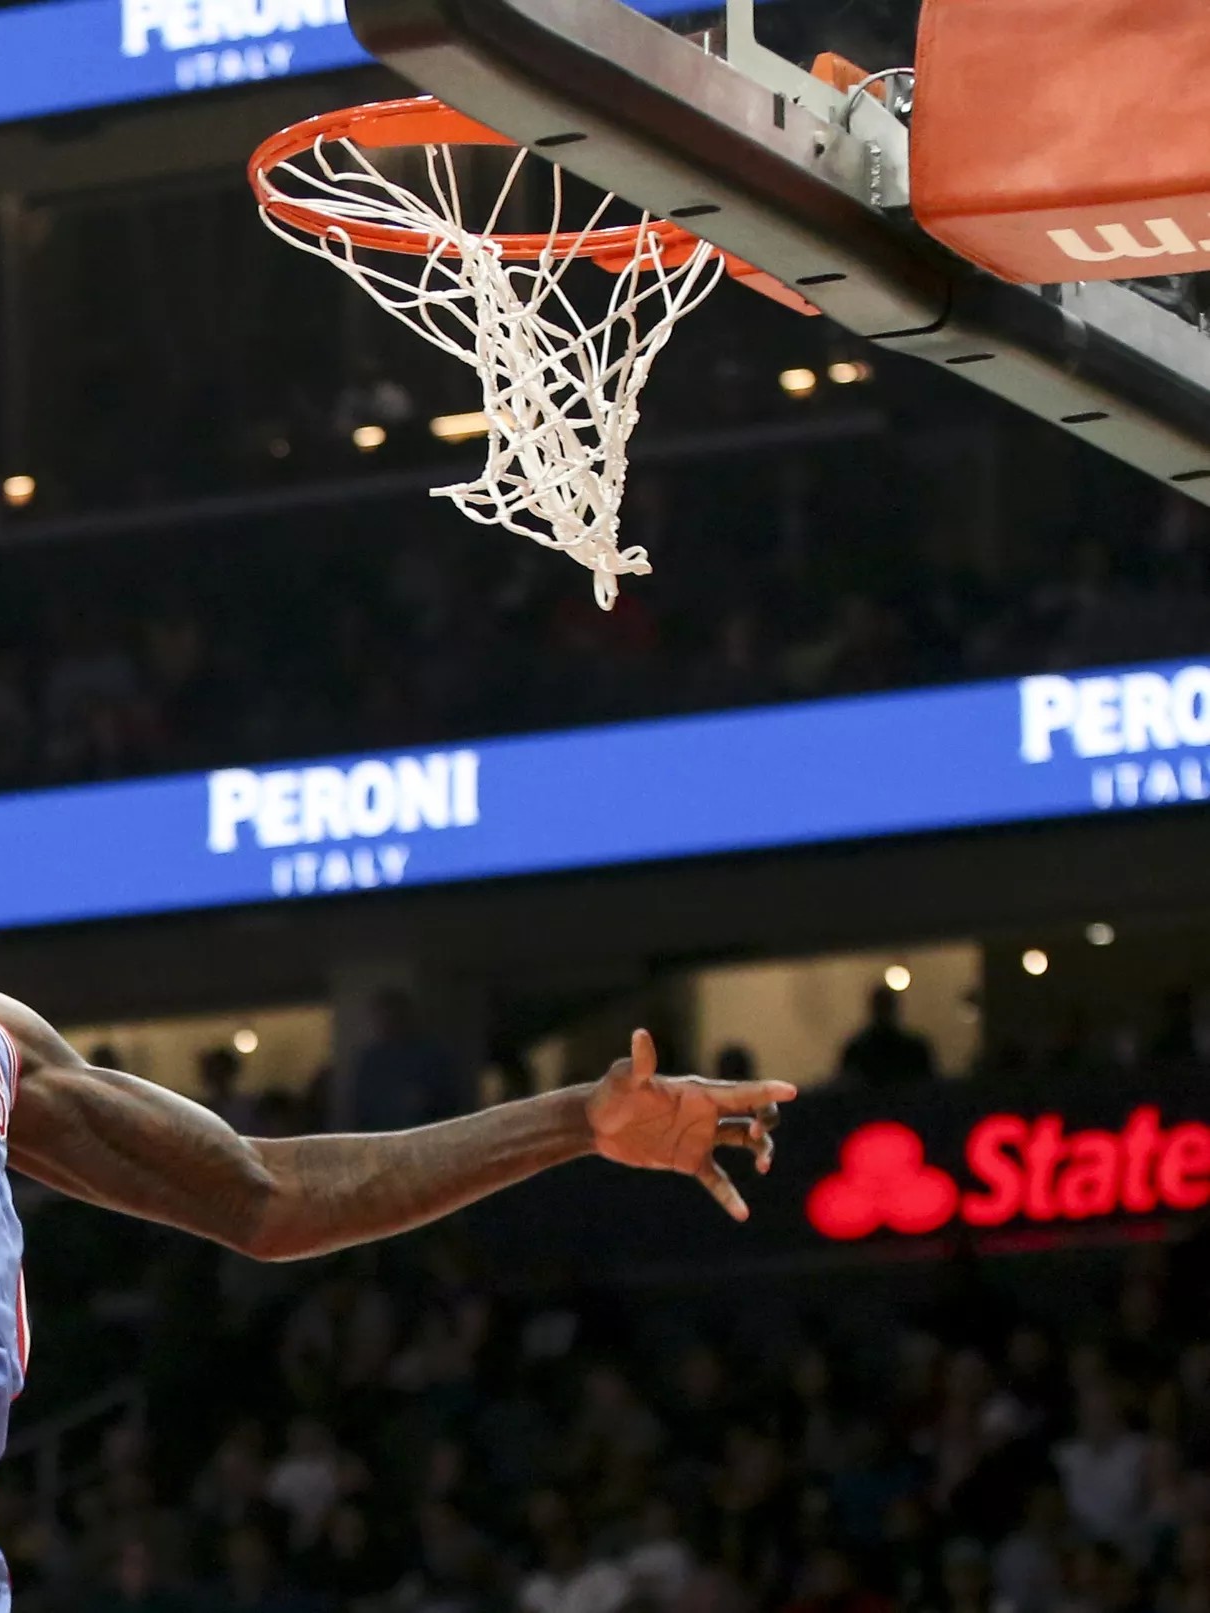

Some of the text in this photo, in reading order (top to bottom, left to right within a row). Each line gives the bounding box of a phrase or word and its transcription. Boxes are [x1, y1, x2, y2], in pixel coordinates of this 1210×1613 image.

[121, 0, 347, 57] PERO
[175, 40, 293, 90] ITALY
[207, 748, 480, 854] PERONI
[1091, 756, 1210, 810] ITAL
[270, 842, 410, 897] ITALY
[960, 1104, 1210, 1226] State
